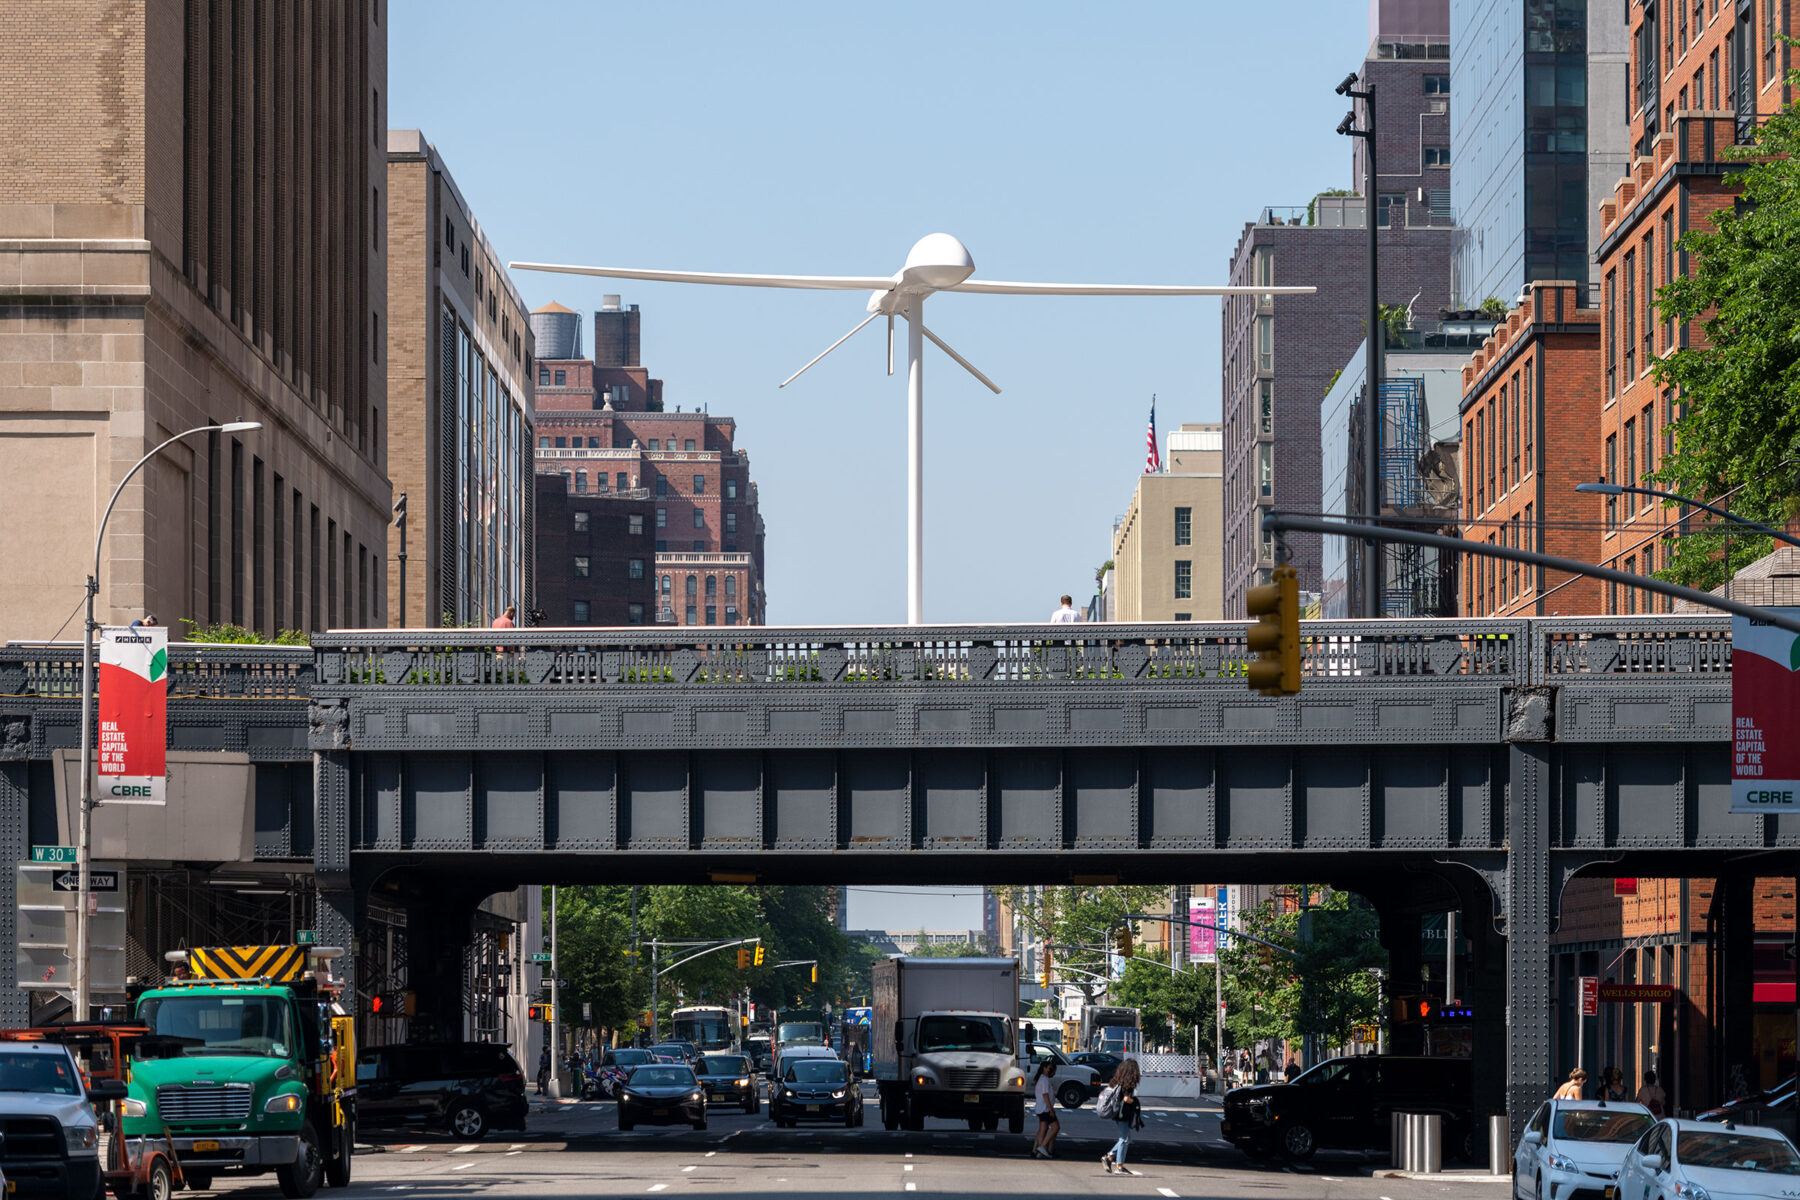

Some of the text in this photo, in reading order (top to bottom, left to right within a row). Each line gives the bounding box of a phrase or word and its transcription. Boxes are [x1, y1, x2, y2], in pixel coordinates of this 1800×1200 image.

[101, 721, 118, 731] REAL
[1736, 717, 1755, 728] REAL
[101, 732, 125, 741] ESTATE
[1736, 729, 1763, 740] ESTATE
[101, 742, 128, 752] CAPITAL
[1736, 741, 1767, 752] CAPITAL
[101, 752, 124, 762] OF THE
[1736, 753, 1761, 764] OF THE
[101, 763, 125, 772] WORLD
[1736, 765, 1763, 775] WORLD
[111, 785, 151, 797] CBRE
[1746, 790, 1793, 804] CBRE
[35, 848, 44, 860] W
[49, 848, 64, 860] 30
[62, 876, 79, 886] ONE
[1602, 989, 1672, 998] WELLS FARGO
